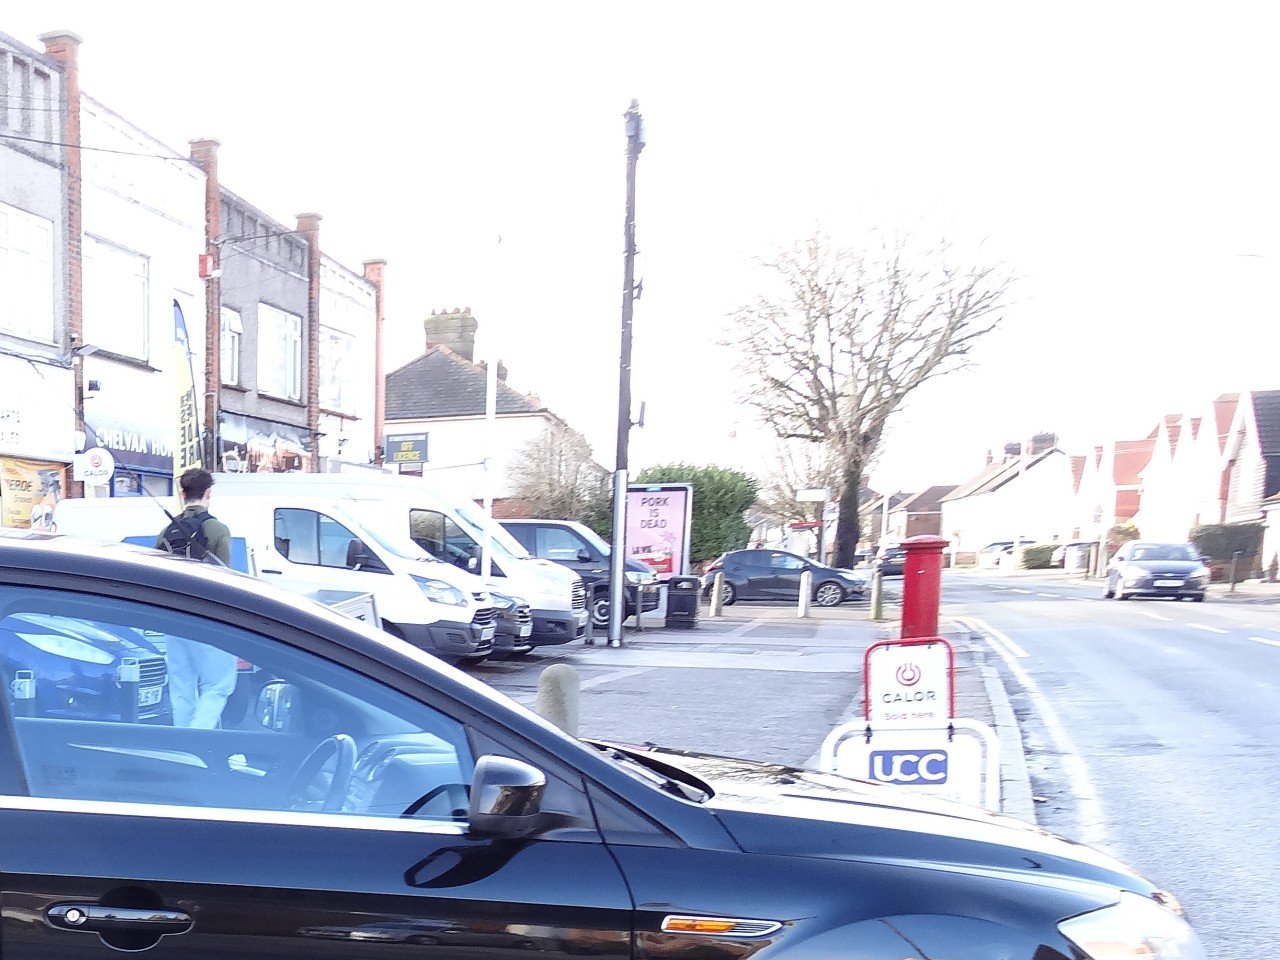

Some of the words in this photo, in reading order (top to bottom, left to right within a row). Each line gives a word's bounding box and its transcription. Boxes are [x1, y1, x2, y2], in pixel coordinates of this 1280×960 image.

[640, 497, 671, 507] PORK
[649, 508, 660, 518] IS
[640, 519, 668, 529] DEAD
[882, 690, 937, 704] CALOR
[873, 752, 947, 782] UCC
